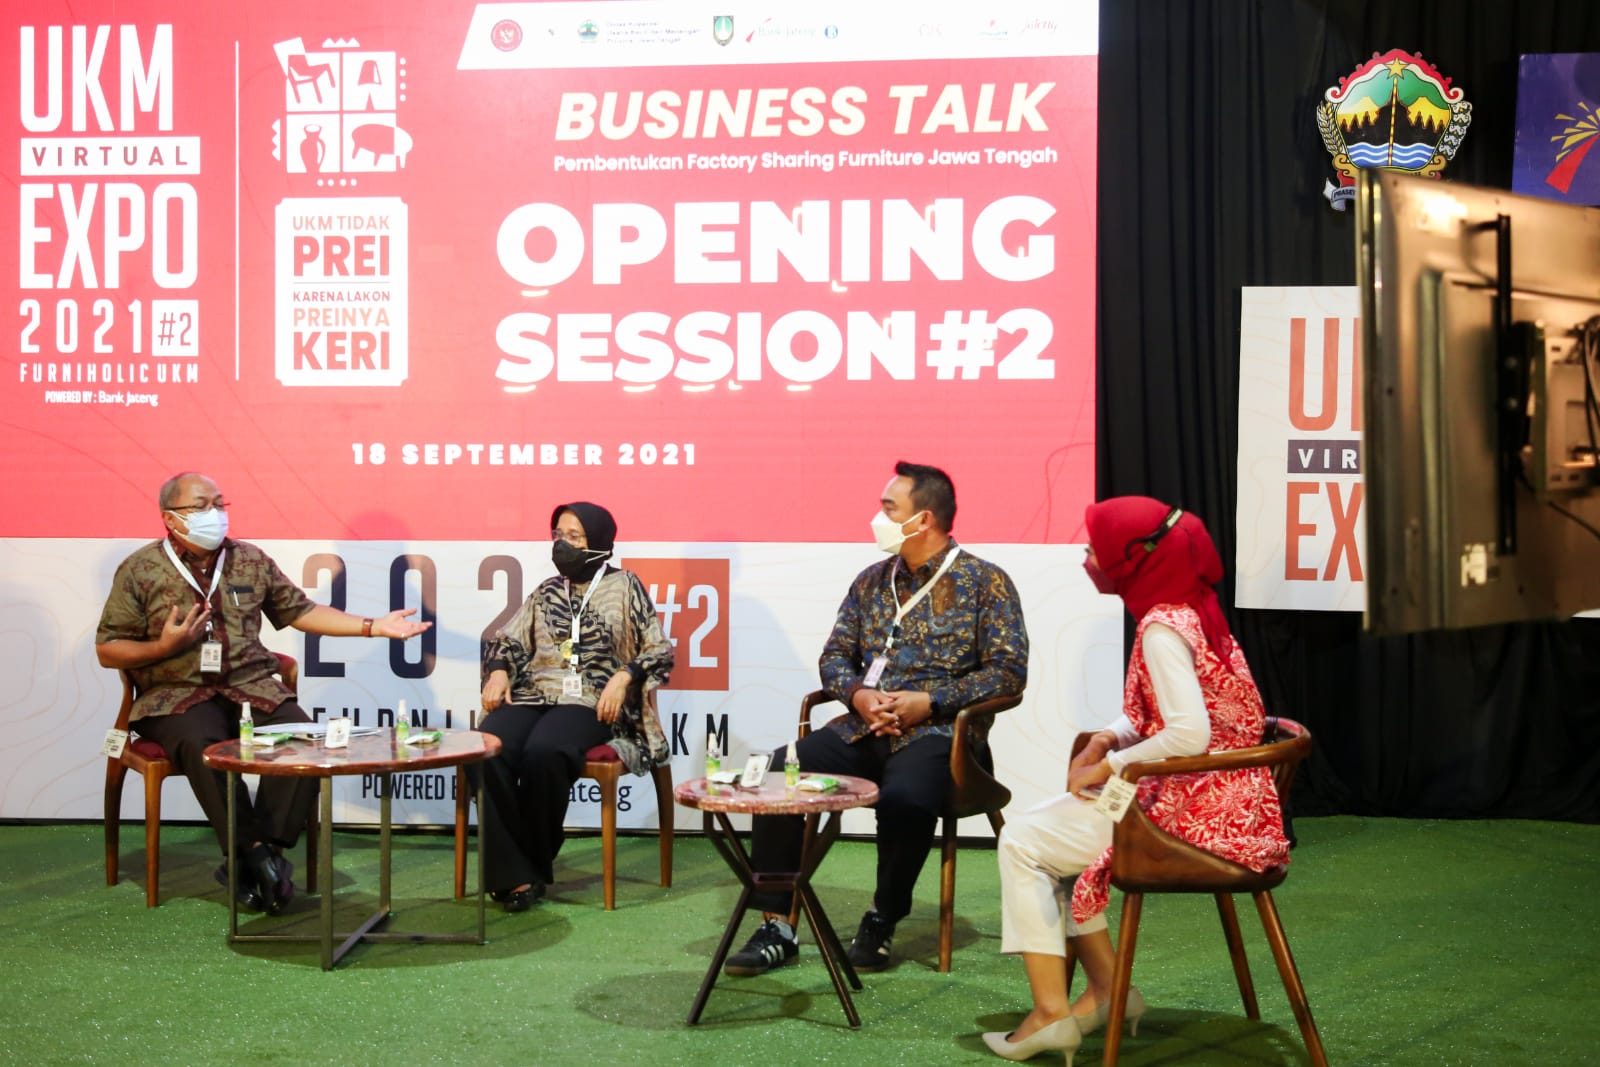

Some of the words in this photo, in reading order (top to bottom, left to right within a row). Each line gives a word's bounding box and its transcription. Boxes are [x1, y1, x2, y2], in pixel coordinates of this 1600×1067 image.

[20, 24, 173, 131] UKM
[555, 86, 867, 141] BUSINESS
[888, 82, 1057, 135] TALK
[32, 146, 187, 166] VIRTUAL
[554, 154, 683, 171] Pembentukan
[688, 154, 757, 173] Factory
[762, 150, 834, 172] Sharing
[839, 149, 924, 167] Furniture
[928, 149, 980, 165] Jawa
[984, 146, 1057, 168] Tengah
[20, 183, 198, 288] EXPO
[293, 216, 332, 230] UKM
[337, 216, 389, 230] TIDAK
[496, 195, 1057, 286] OPENING
[293, 235, 390, 277] PREI
[293, 291, 344, 302] KARENA
[347, 291, 390, 302] LAKON
[20, 299, 141, 353] 2021
[157, 312, 192, 346] #2
[293, 308, 390, 327] PREINYA
[293, 331, 390, 371] KERI
[1289, 317, 1362, 432] U
[45, 391, 81, 403] POWERED
[99, 391, 124, 403] Bank
[125, 392, 158, 406] Jateng
[352, 443, 386, 465] 18
[402, 443, 603, 465] SEPTEMBER
[618, 443, 695, 465] 2021
[302, 553, 523, 679] 202
[362, 774, 445, 800] POWERED
